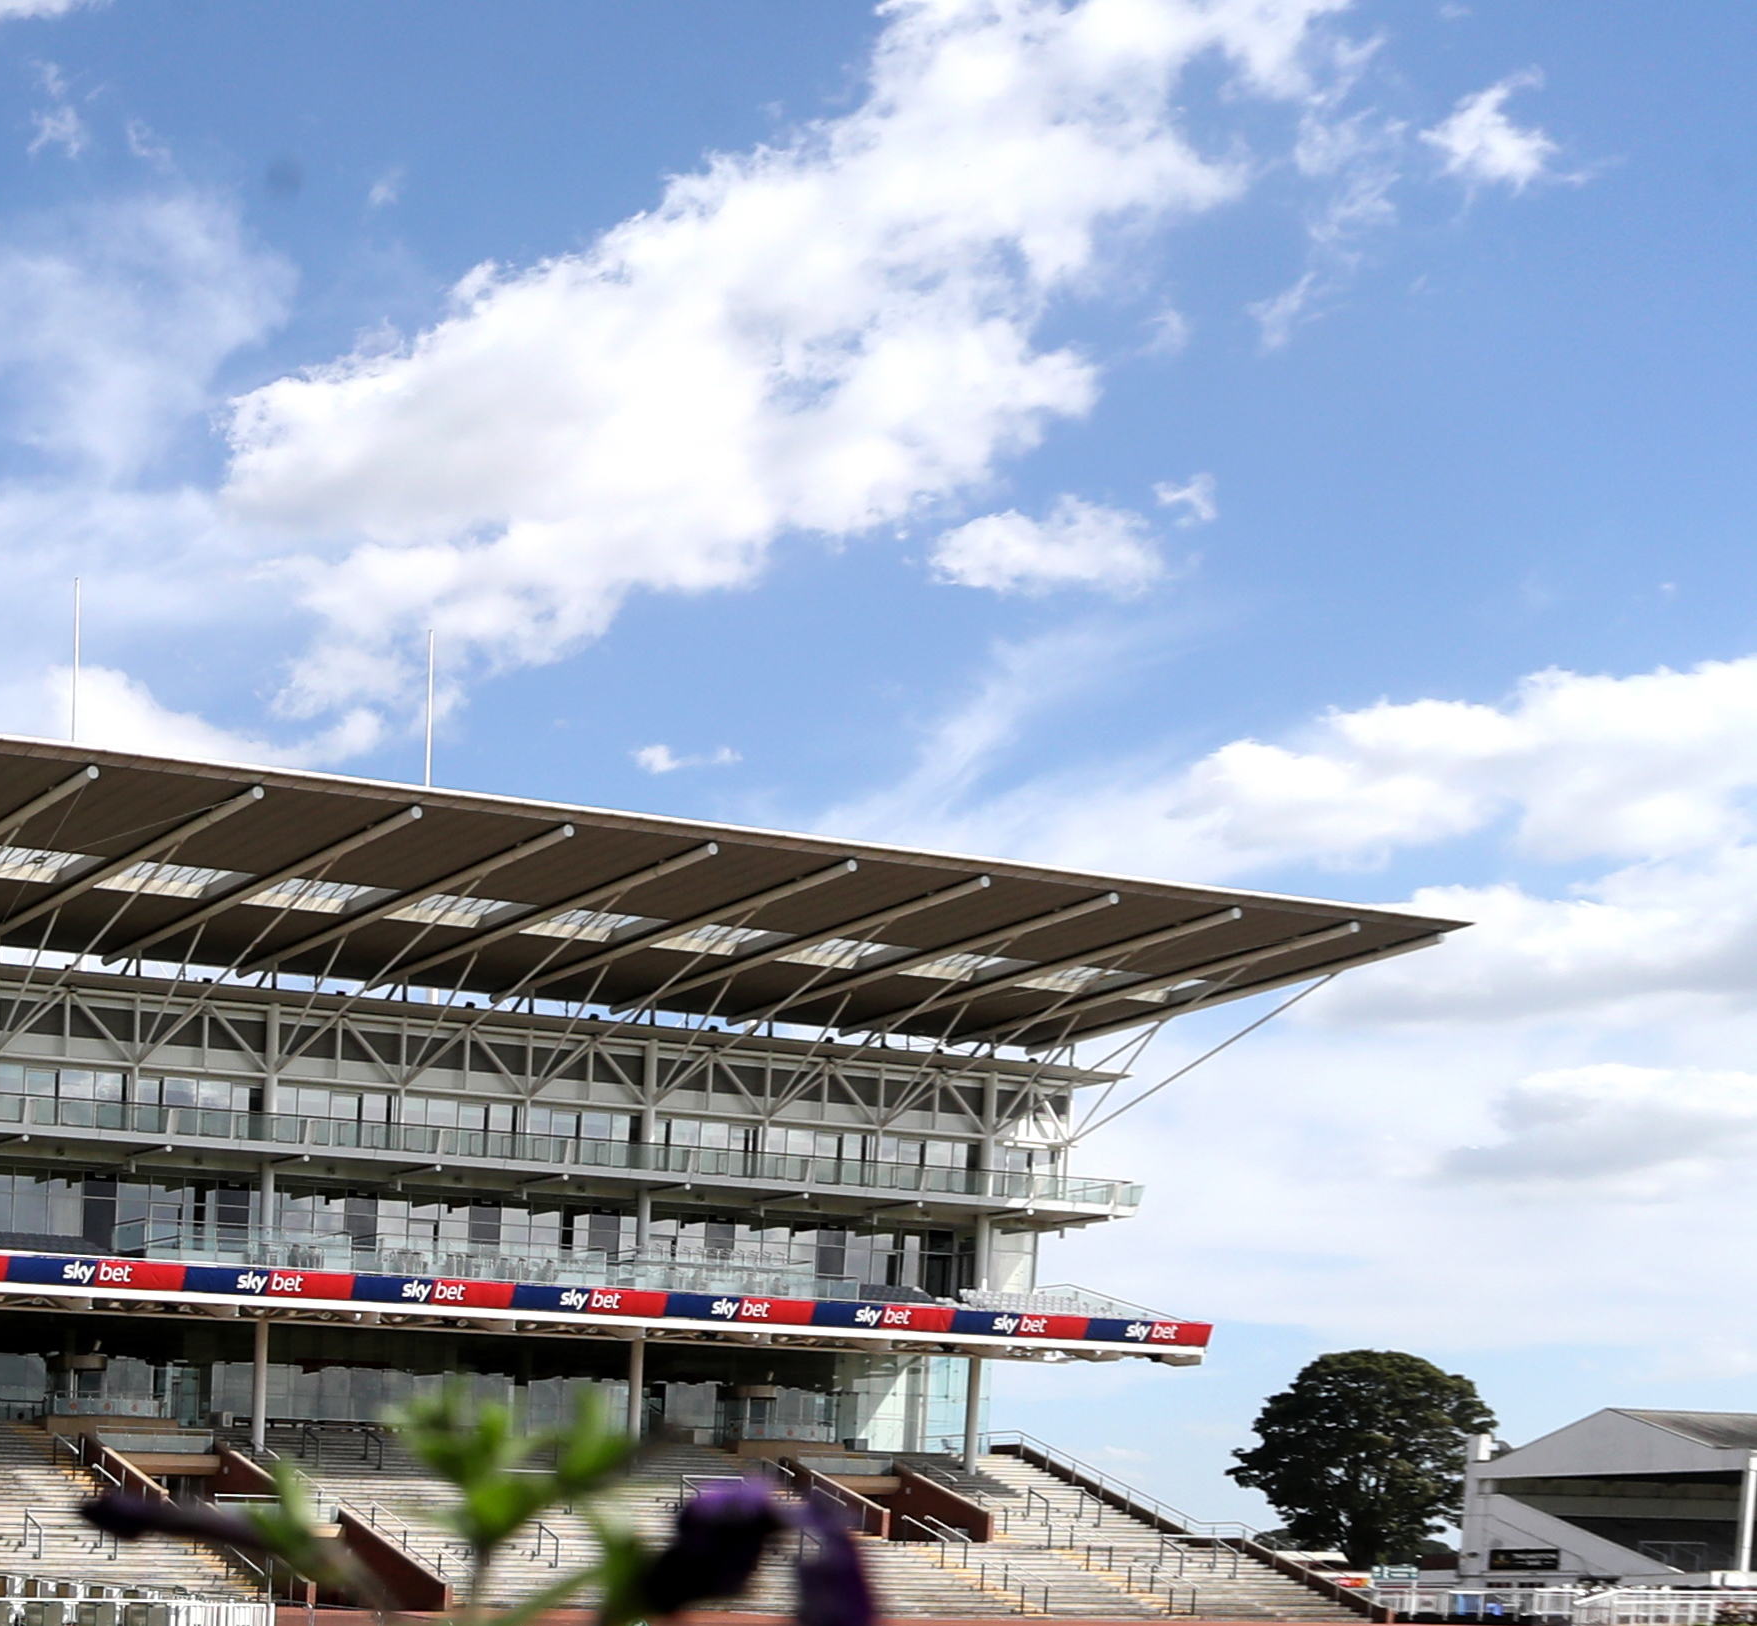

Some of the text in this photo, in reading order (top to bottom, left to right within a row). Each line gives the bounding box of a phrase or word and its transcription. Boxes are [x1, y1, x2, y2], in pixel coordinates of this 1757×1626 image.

[62, 1260, 133, 1284] sky bet
[236, 1270, 304, 1294] sky bet
[401, 1279, 466, 1302] sky bet
[559, 1288, 622, 1311] sky bet
[711, 1297, 771, 1319] sky bet
[854, 1305, 912, 1327] sky bet
[992, 1314, 1048, 1335] sky bet
[1124, 1321, 1179, 1342] sky bet
